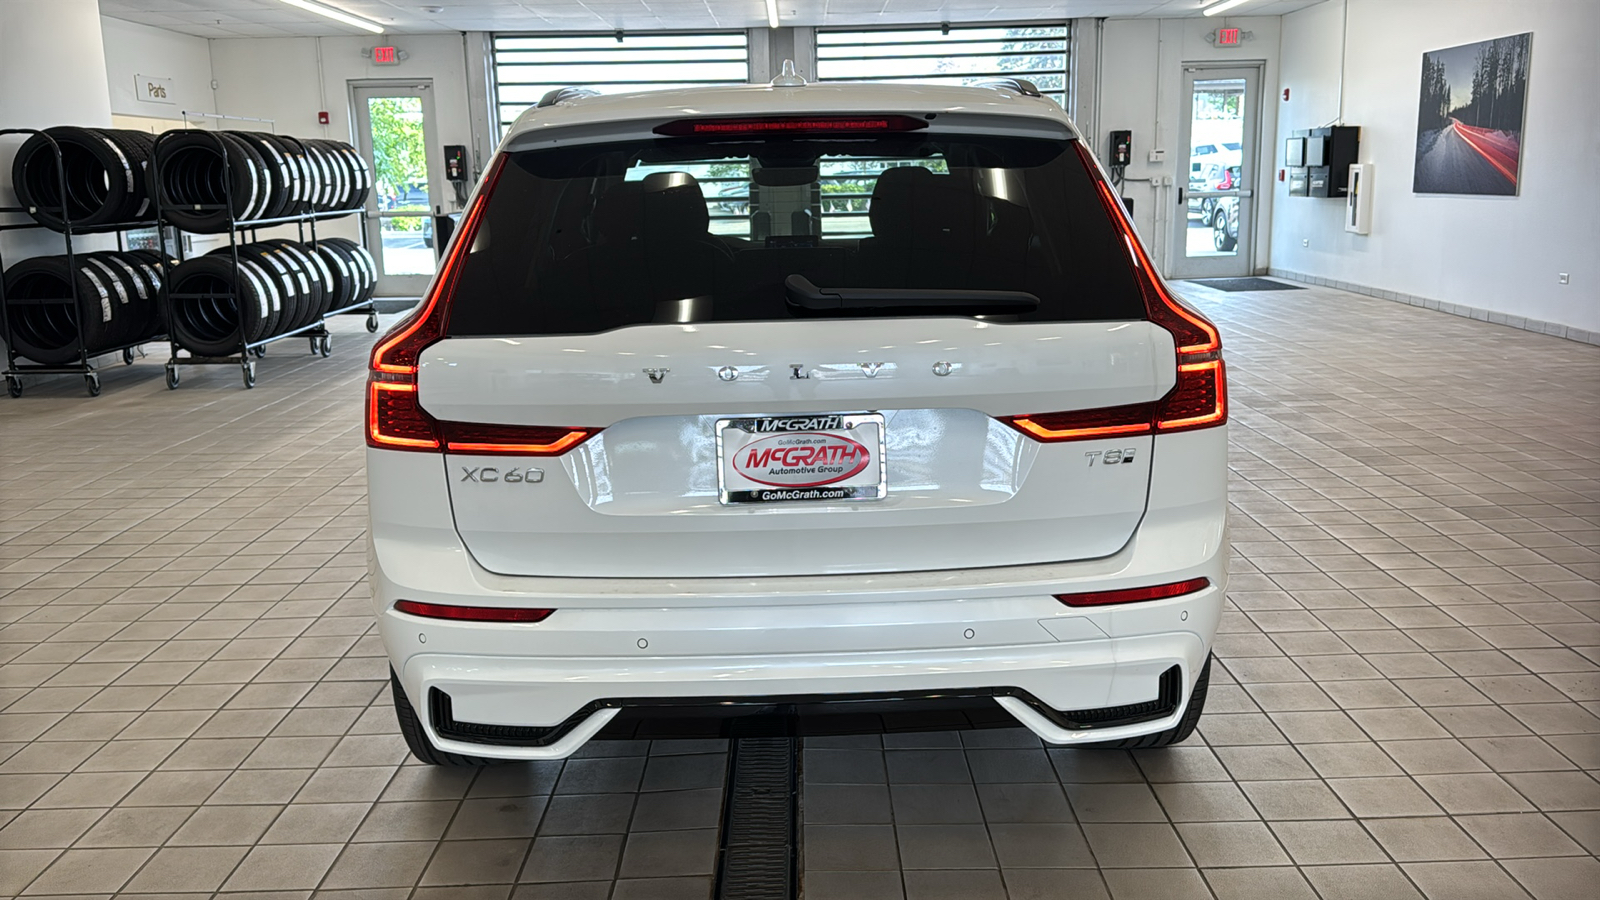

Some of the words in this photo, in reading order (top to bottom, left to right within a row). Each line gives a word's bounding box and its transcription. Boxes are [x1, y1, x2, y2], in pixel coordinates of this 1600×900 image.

[1220, 28, 1238, 44] EXIT
[375, 47, 394, 62] EXIT
[147, 82, 167, 99] Parts
[642, 360, 953, 384] VOLVO
[777, 438, 827, 446] GoMcGrath.com
[768, 467, 816, 476] Automotive
[817, 465, 844, 475] Group
[762, 490, 844, 501] GoMcGrath.com
